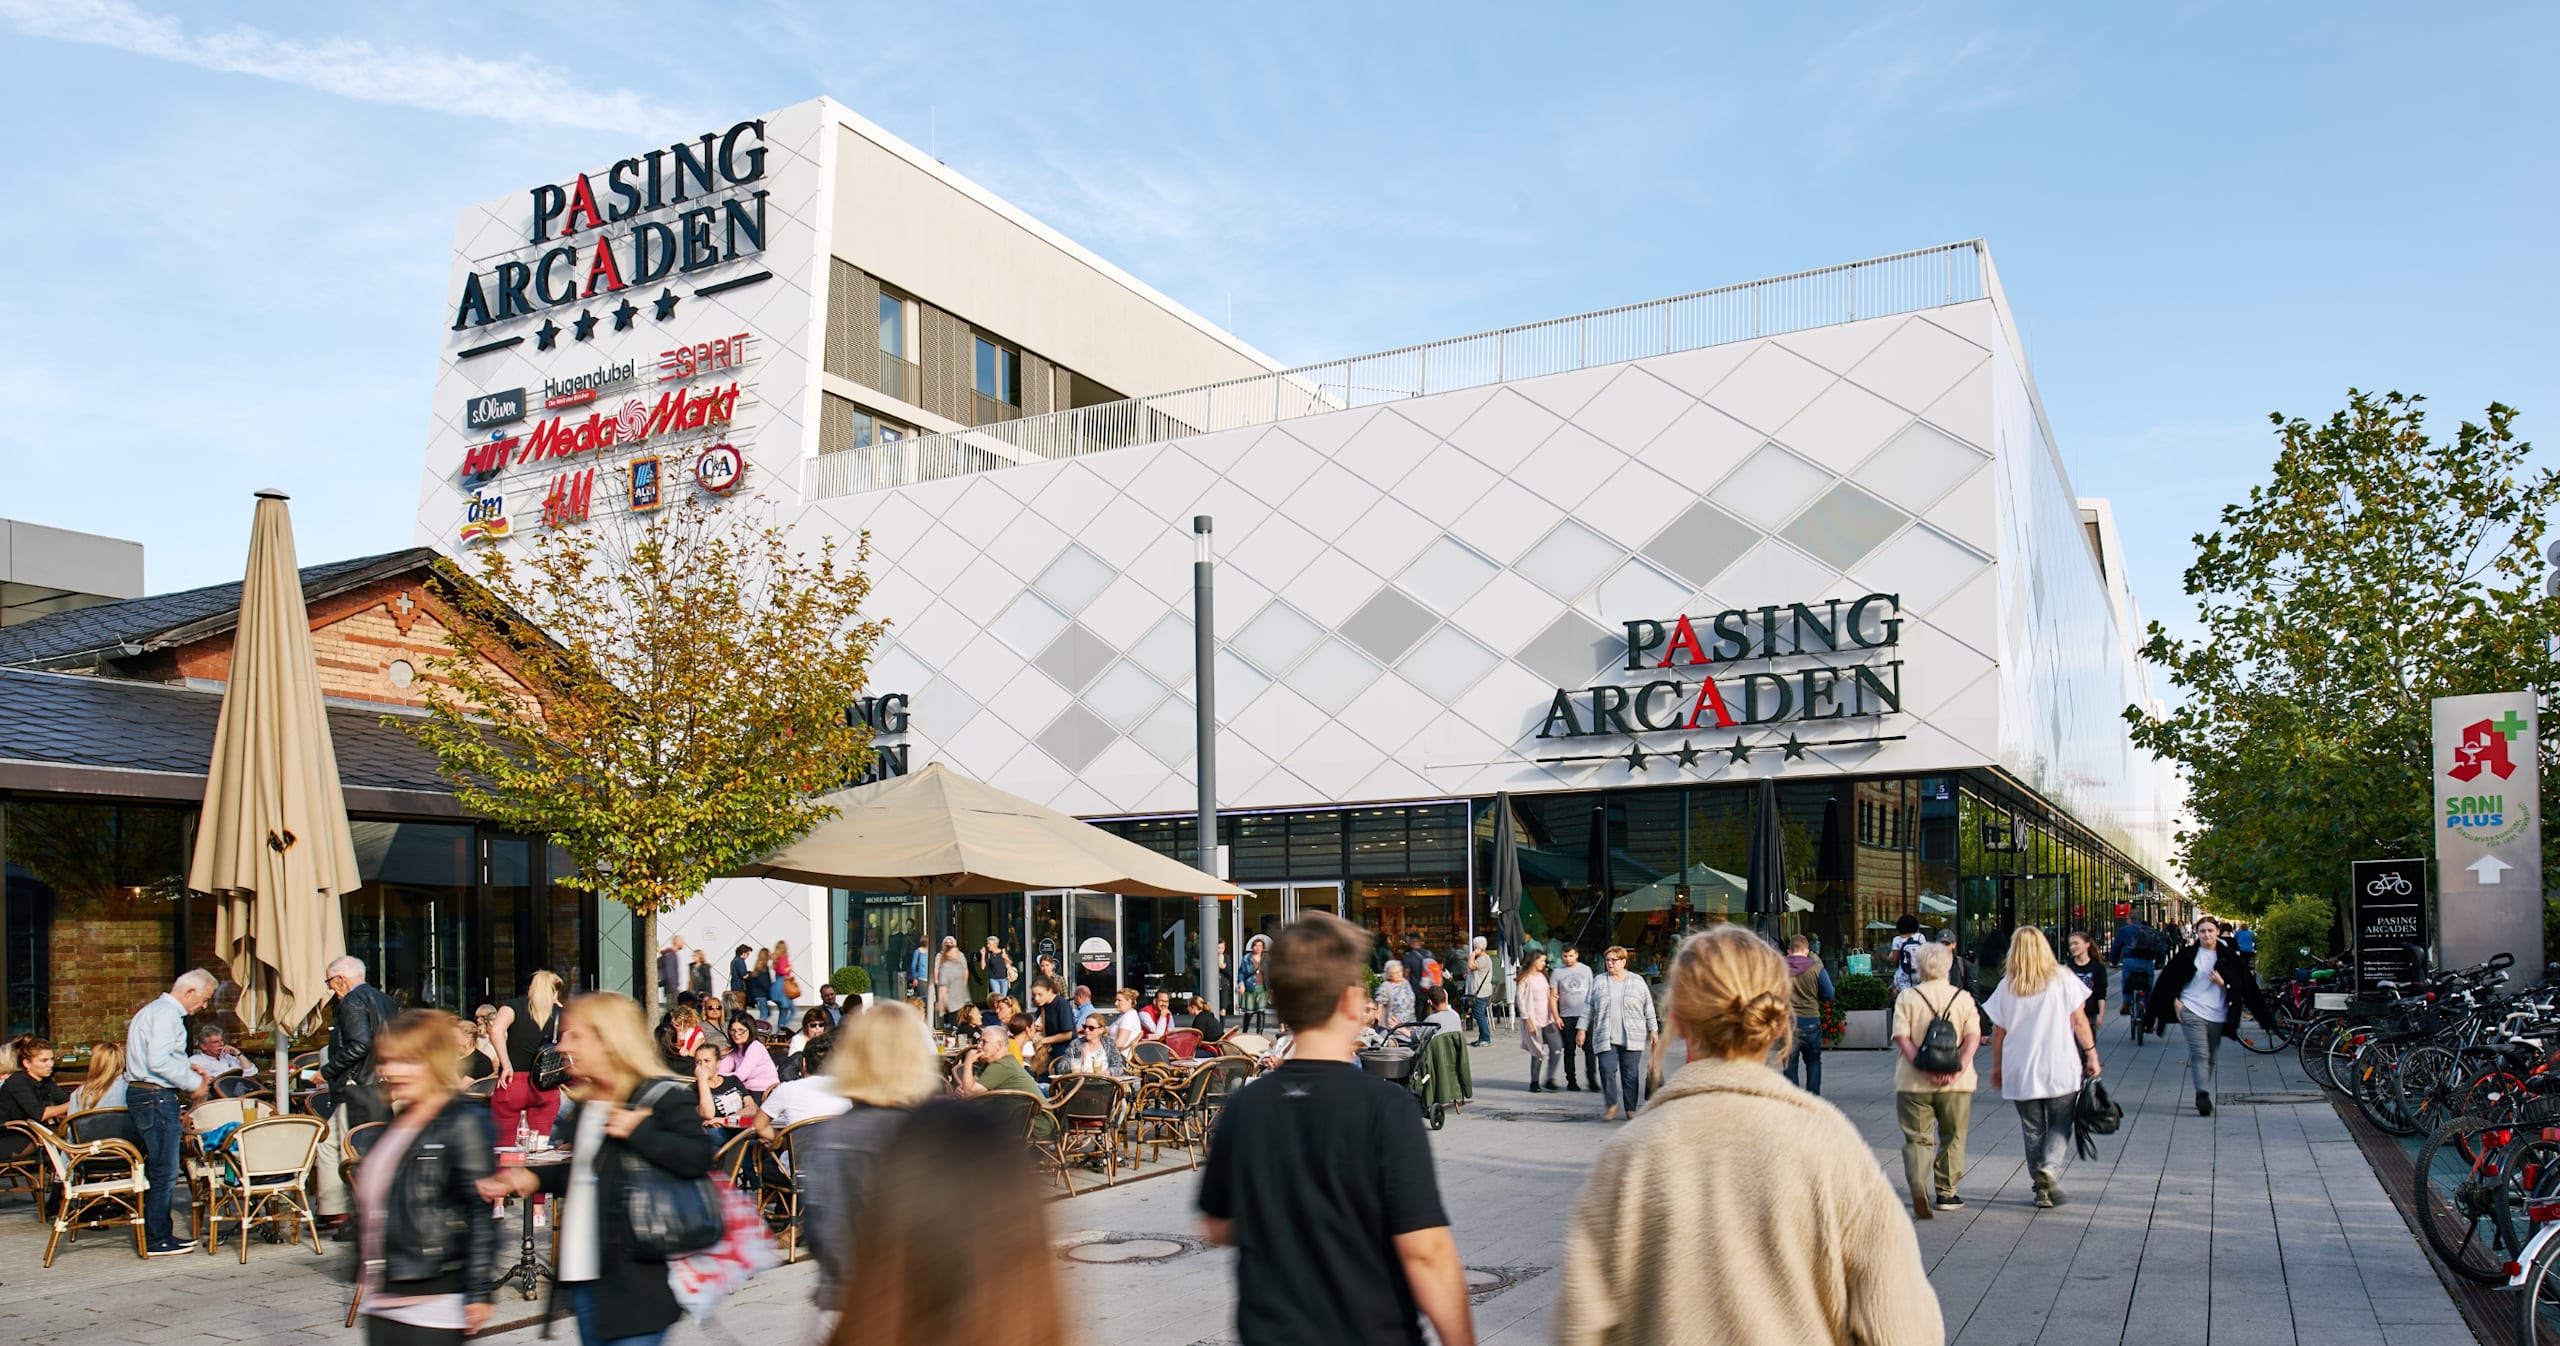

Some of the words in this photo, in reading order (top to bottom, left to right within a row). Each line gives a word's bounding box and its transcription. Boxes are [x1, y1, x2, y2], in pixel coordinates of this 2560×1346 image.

[530, 118, 769, 244] PASING
[452, 190, 770, 331] ARCADEN
[659, 332, 749, 382] ESPRIT
[545, 358, 635, 398] Hugendubel
[472, 397, 517, 424] s.Oliver
[517, 413, 618, 465] Media
[641, 382, 743, 438] Markt
[702, 455, 733, 478] C&A
[468, 490, 503, 523] dm
[542, 467, 595, 526] H&M
[1623, 593, 1903, 671] PASING
[1536, 660, 1904, 739] ARCADEN
[1938, 785, 1945, 793] 5
[2446, 795, 2503, 815] SANI
[2447, 813, 2504, 828] PLUS
[2365, 925, 2417, 933] ARCADEN
[2377, 916, 2417, 925] PASING
[1162, 919, 1185, 974] 1
